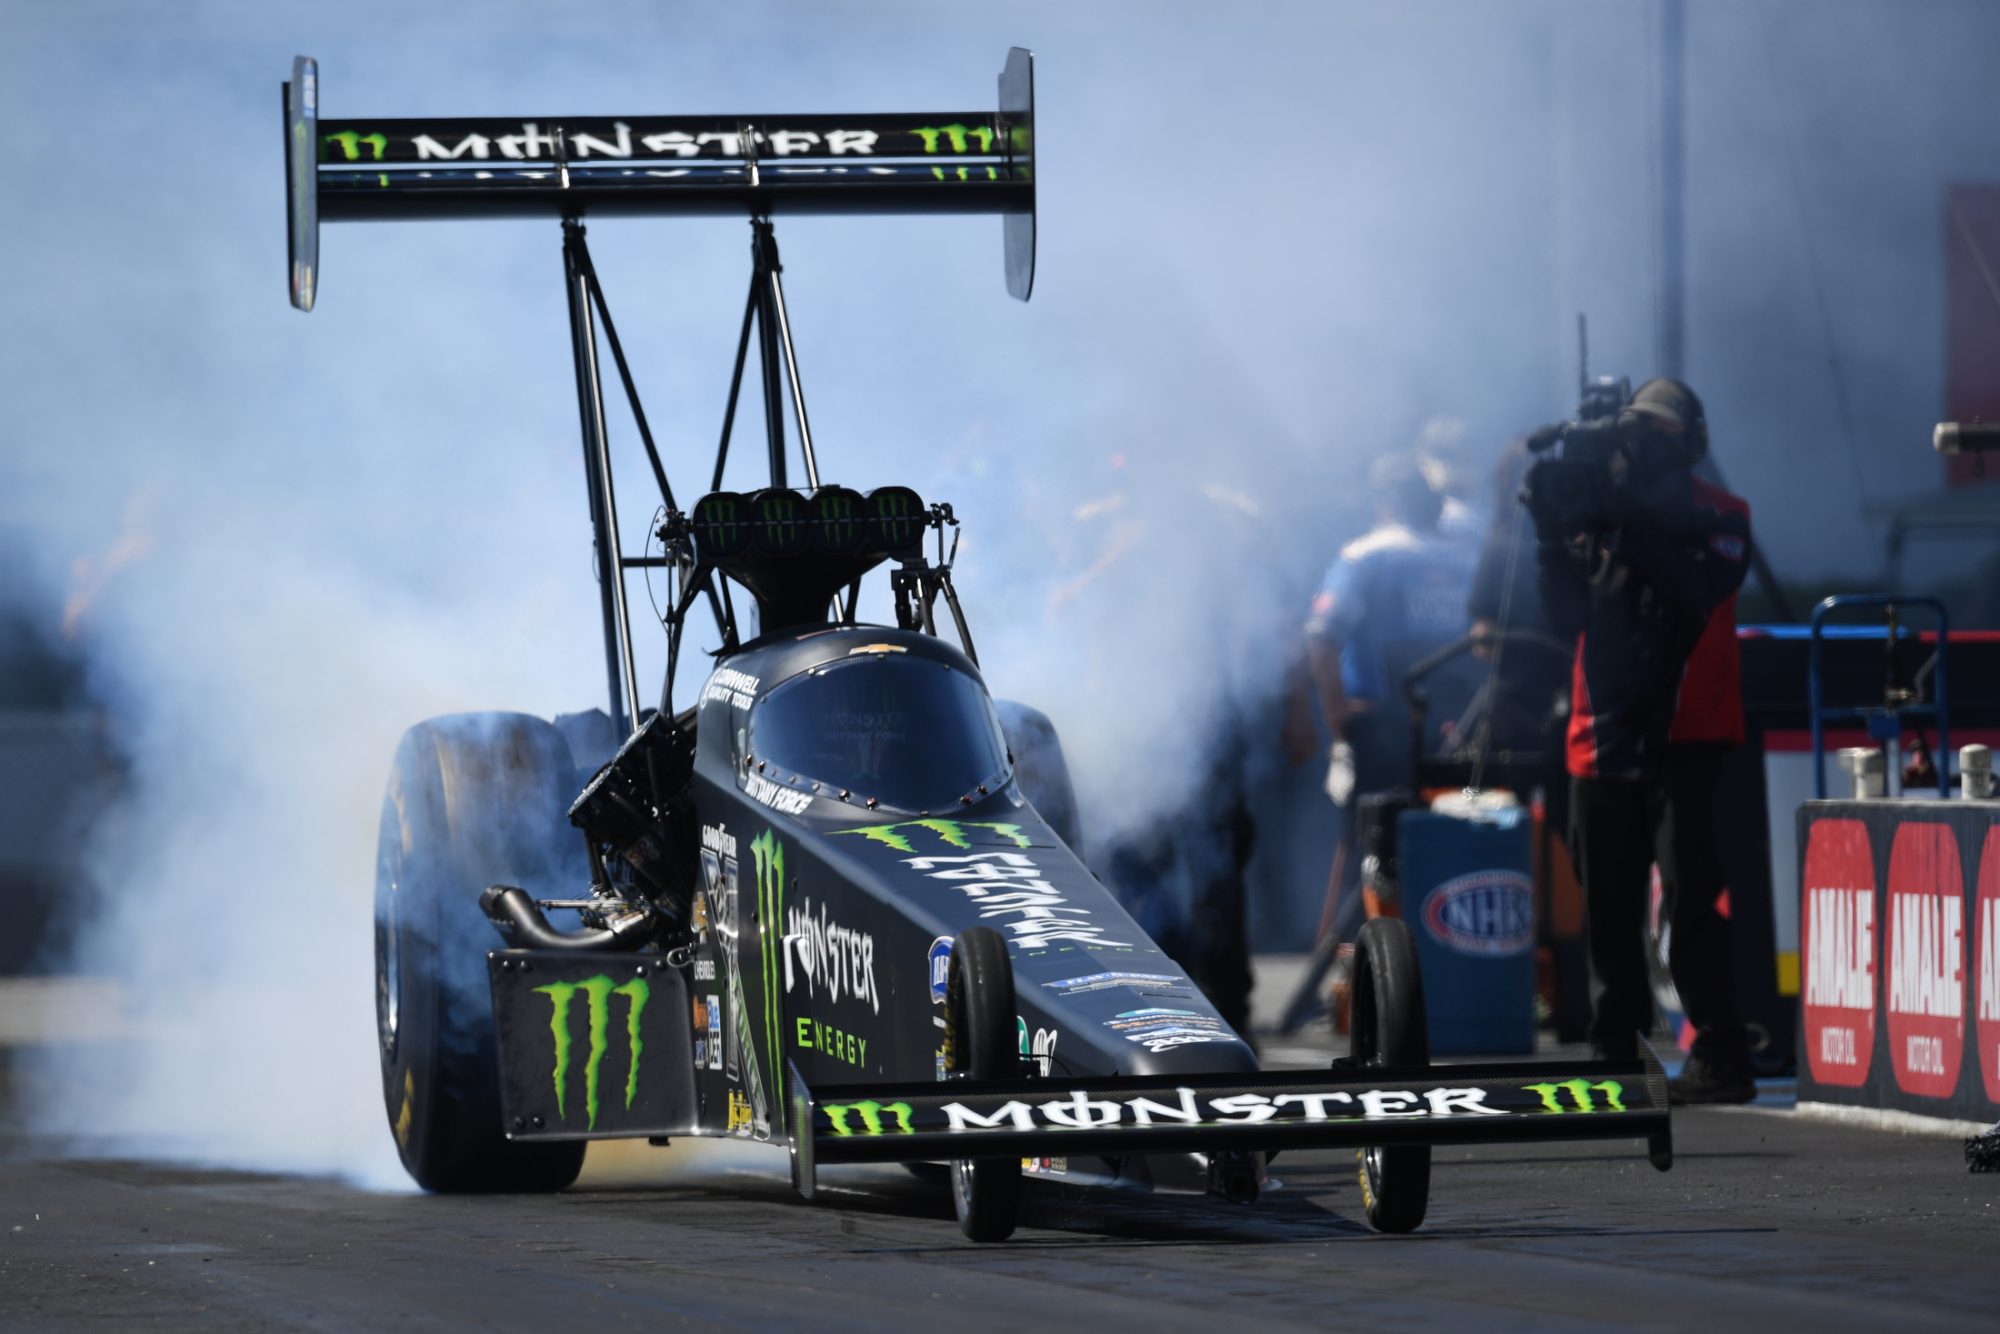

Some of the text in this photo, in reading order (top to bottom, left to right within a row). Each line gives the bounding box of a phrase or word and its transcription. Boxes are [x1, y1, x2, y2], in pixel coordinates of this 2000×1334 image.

[411, 122, 879, 161] MONSTER
[899, 852, 1133, 948] MONSTER
[783, 896, 879, 1016] MONSTER
[1807, 888, 1873, 1009] AMALIE
[1890, 893, 1961, 1017] AMALIE
[797, 1017, 867, 1068] ENERGY
[940, 1087, 1510, 1132] MONSTER
